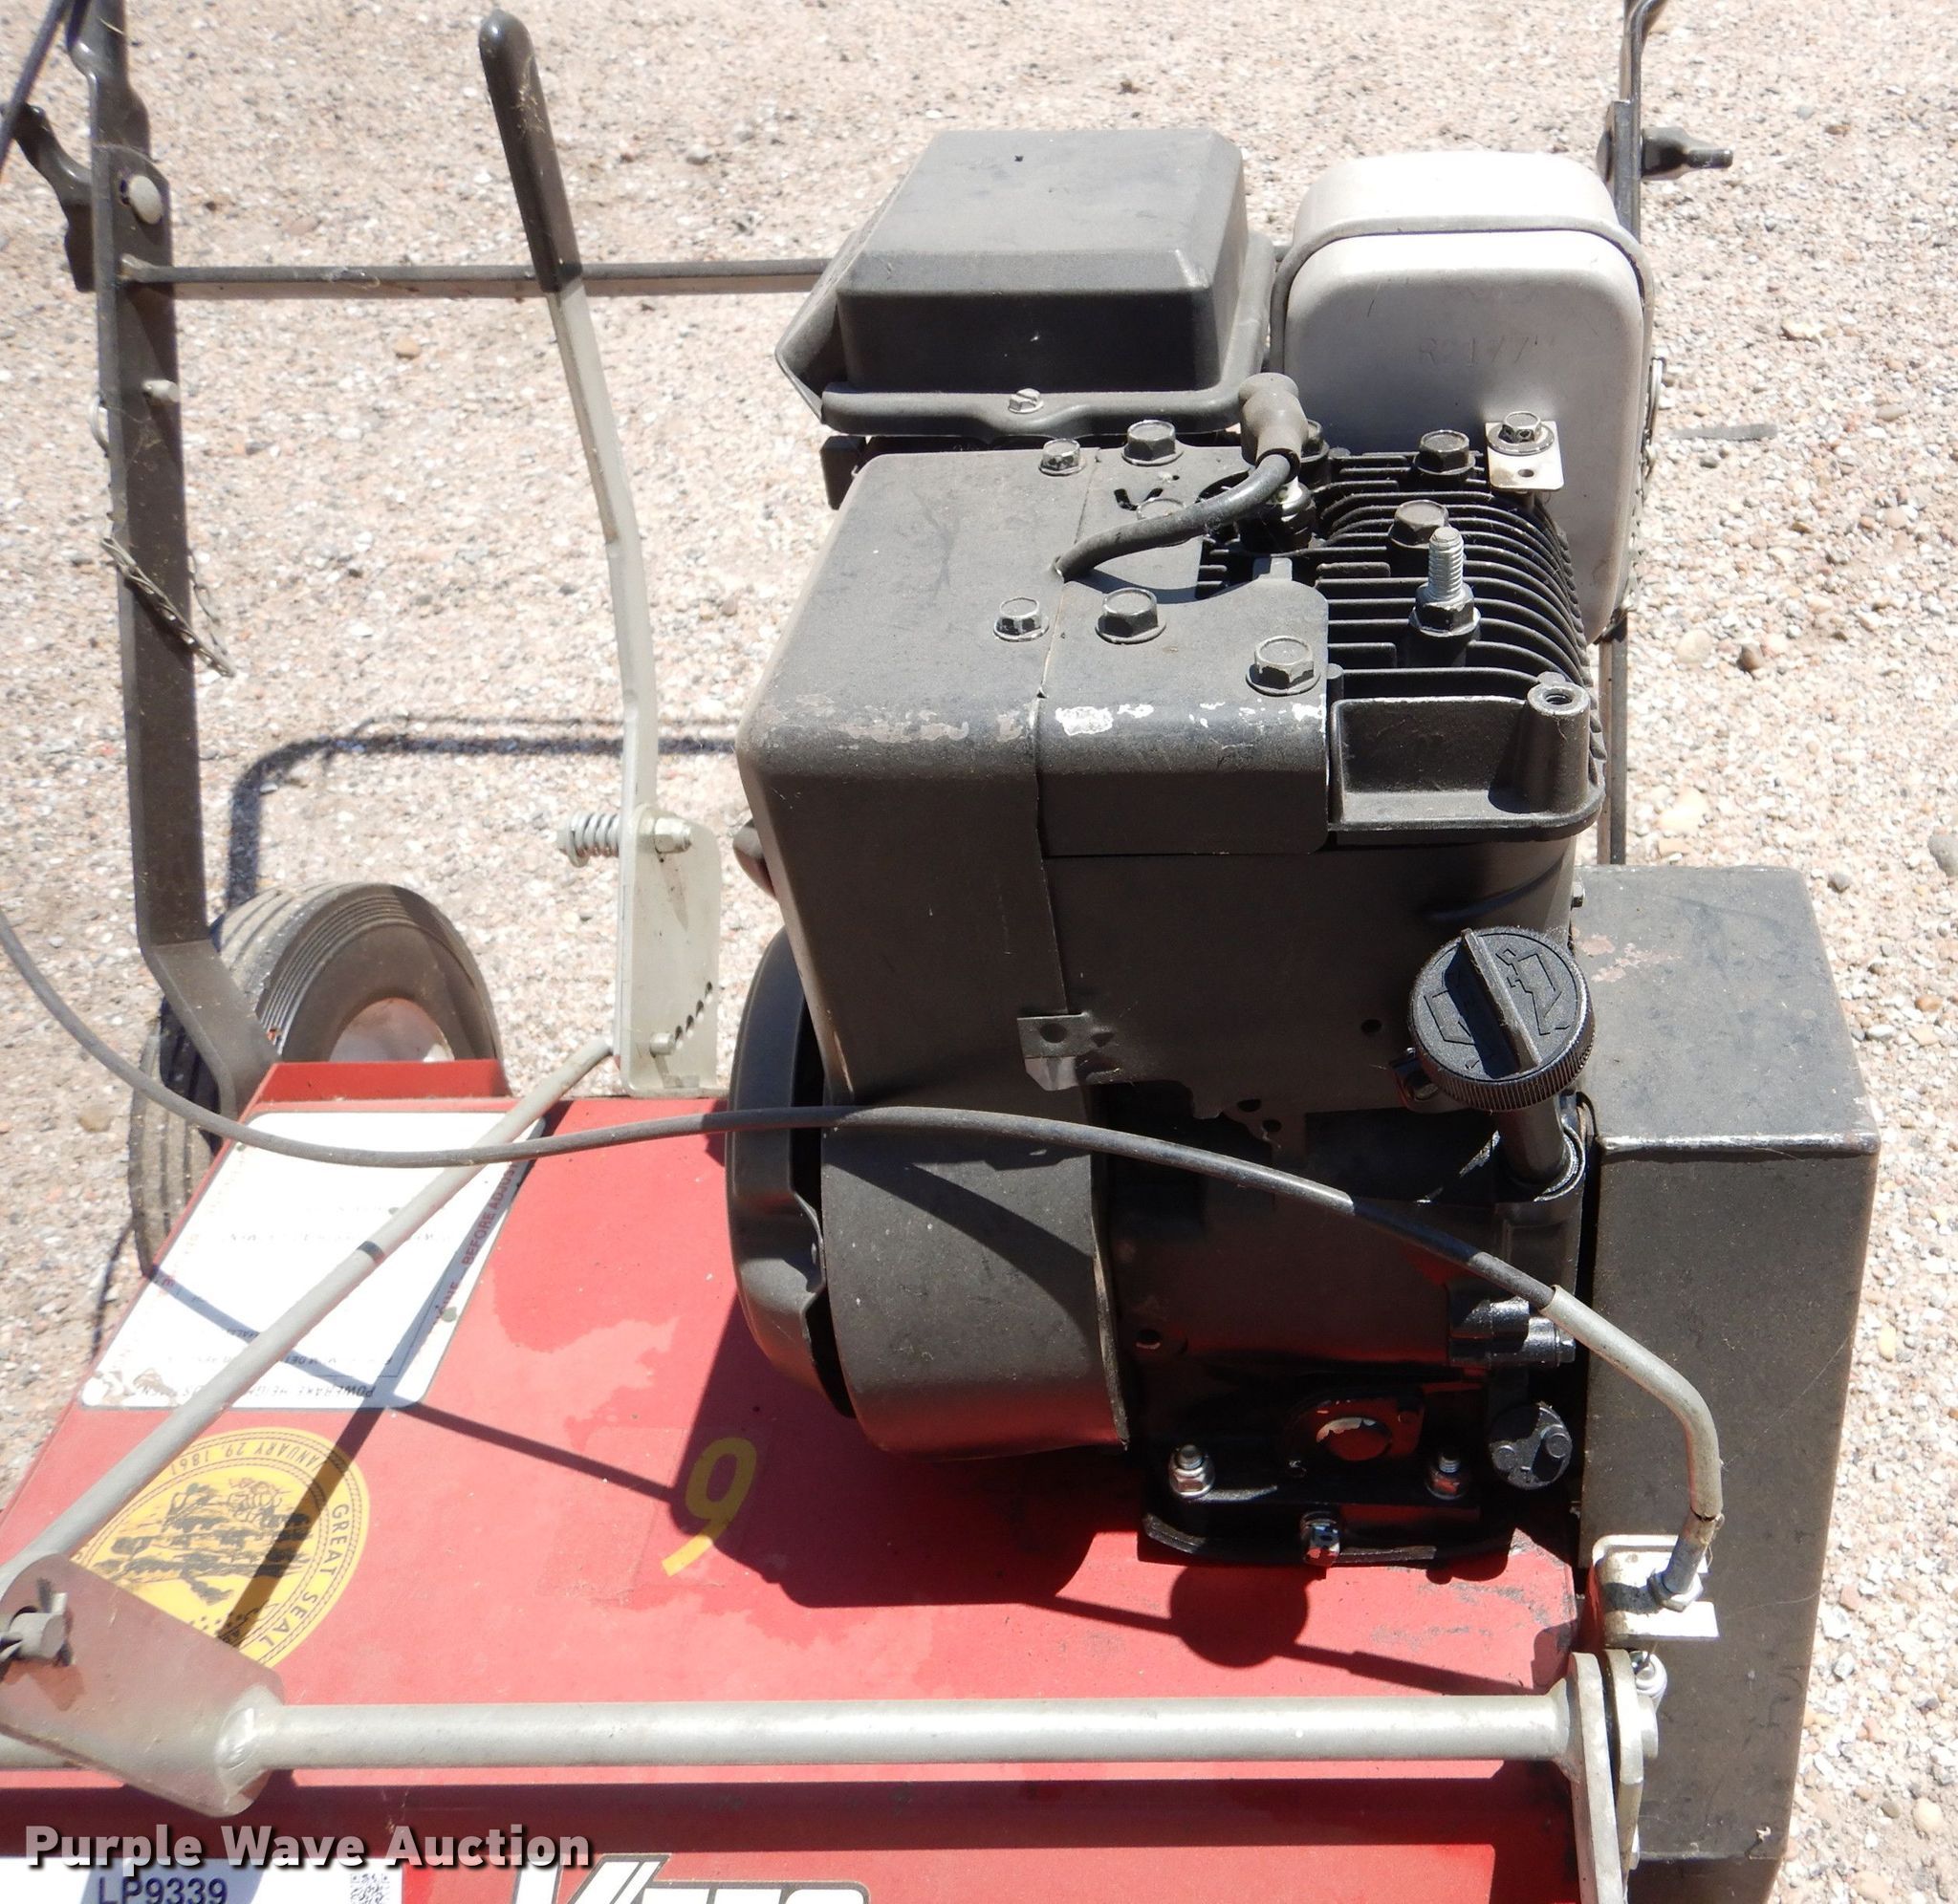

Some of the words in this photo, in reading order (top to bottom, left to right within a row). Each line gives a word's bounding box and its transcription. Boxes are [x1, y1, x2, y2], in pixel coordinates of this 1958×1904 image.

[461, 1210, 496, 1266] BEFORE
[170, 1450, 209, 1476] 1861
[319, 1503, 350, 1577] GREAT
[259, 1590, 318, 1648] SEAL
[98, 1875, 228, 1904] LP9339
